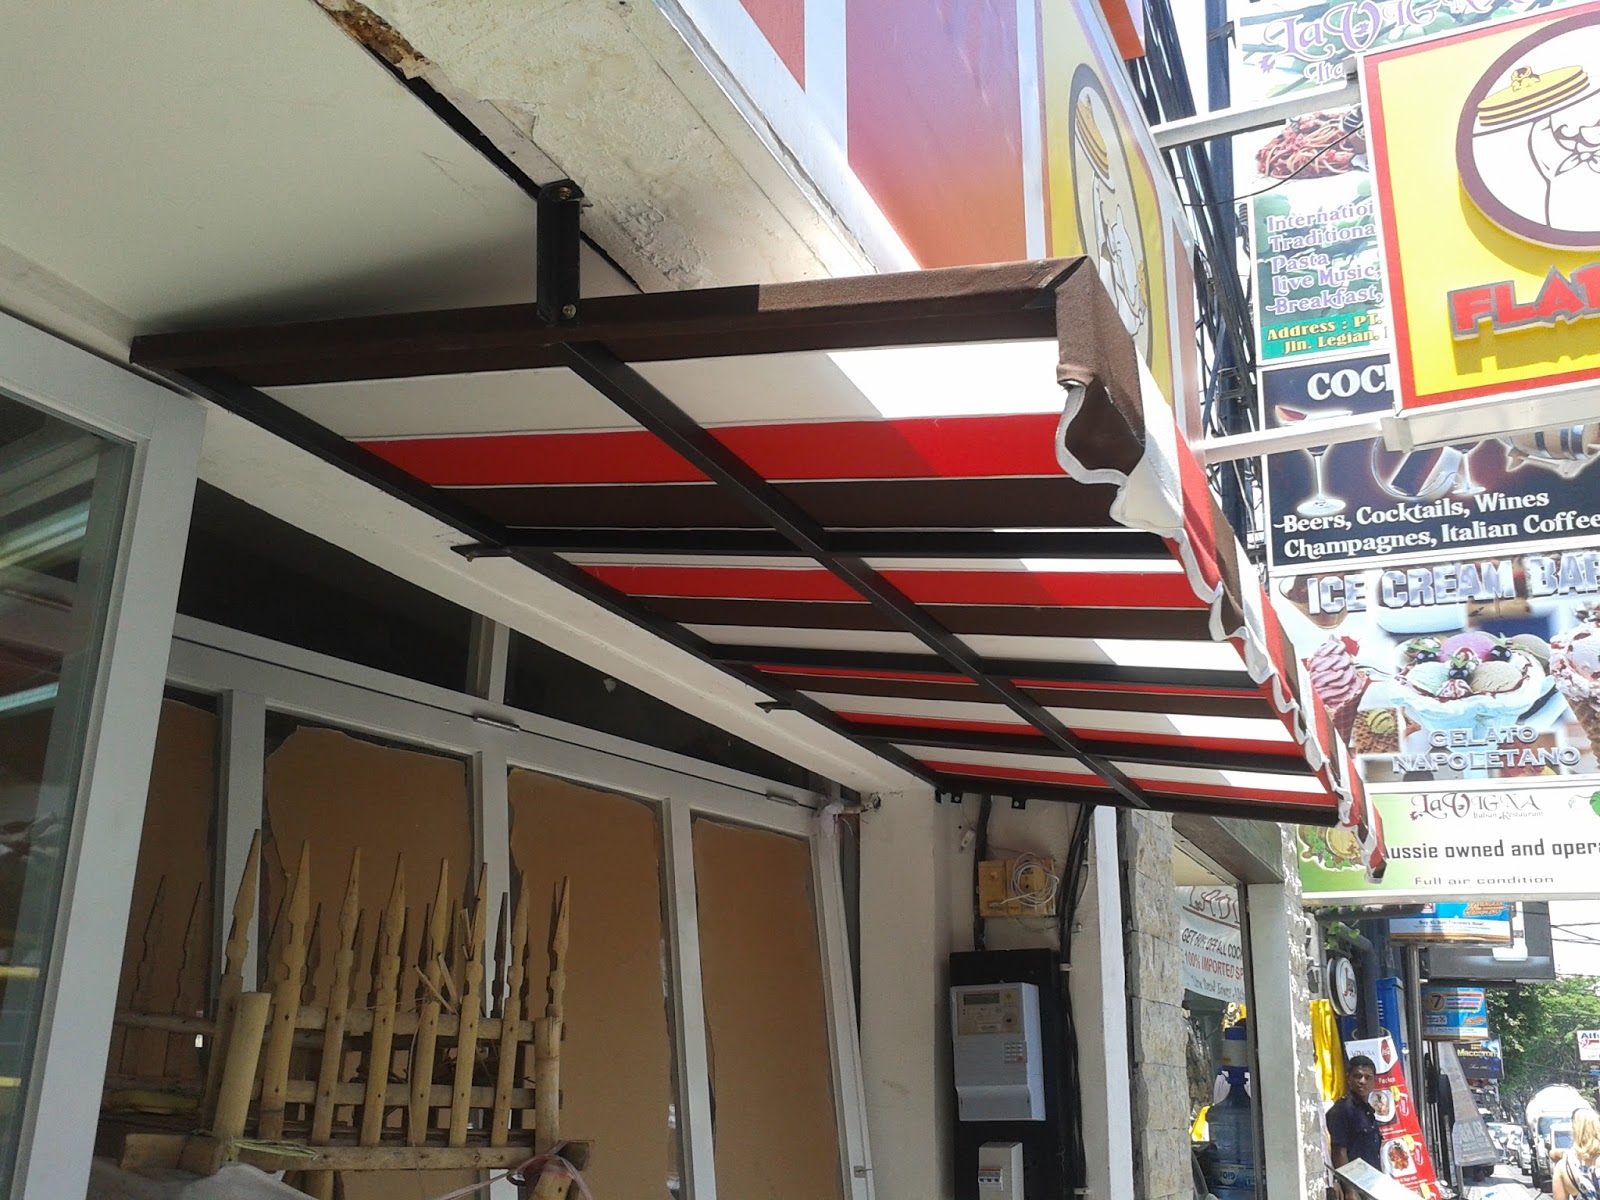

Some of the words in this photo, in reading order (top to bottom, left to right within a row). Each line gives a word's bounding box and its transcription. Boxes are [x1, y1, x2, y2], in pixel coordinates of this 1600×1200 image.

[1272, 254, 1328, 273] Pasta
[1273, 275, 1313, 295] Live
[1320, 265, 1381, 286] Music,
[1267, 287, 1382, 314] Breakfast,
[1267, 320, 1336, 340] Address
[1353, 313, 1382, 328] PT.
[1274, 514, 1352, 533] Beers,
[1356, 498, 1470, 525] Cocktails,
[1474, 492, 1549, 512] Wines
[1284, 530, 1437, 559] Champagnes,
[1441, 520, 1518, 543] Italian
[1307, 573, 1367, 614] ICE
[1381, 559, 1516, 608] CREAM
[1428, 726, 1539, 748] GELATO
[1392, 746, 1581, 774] NAPOLETANO
[1445, 839, 1504, 858] owned
[1511, 838, 1545, 857] and
[1415, 876, 1442, 885] Full
[1448, 877, 1470, 885] air
[1477, 875, 1554, 885] condition
[1182, 928, 1197, 944] GET
[1216, 941, 1227, 956] ALL
[1228, 943, 1242, 960] COC
[1202, 956, 1234, 978] IMPORTED
